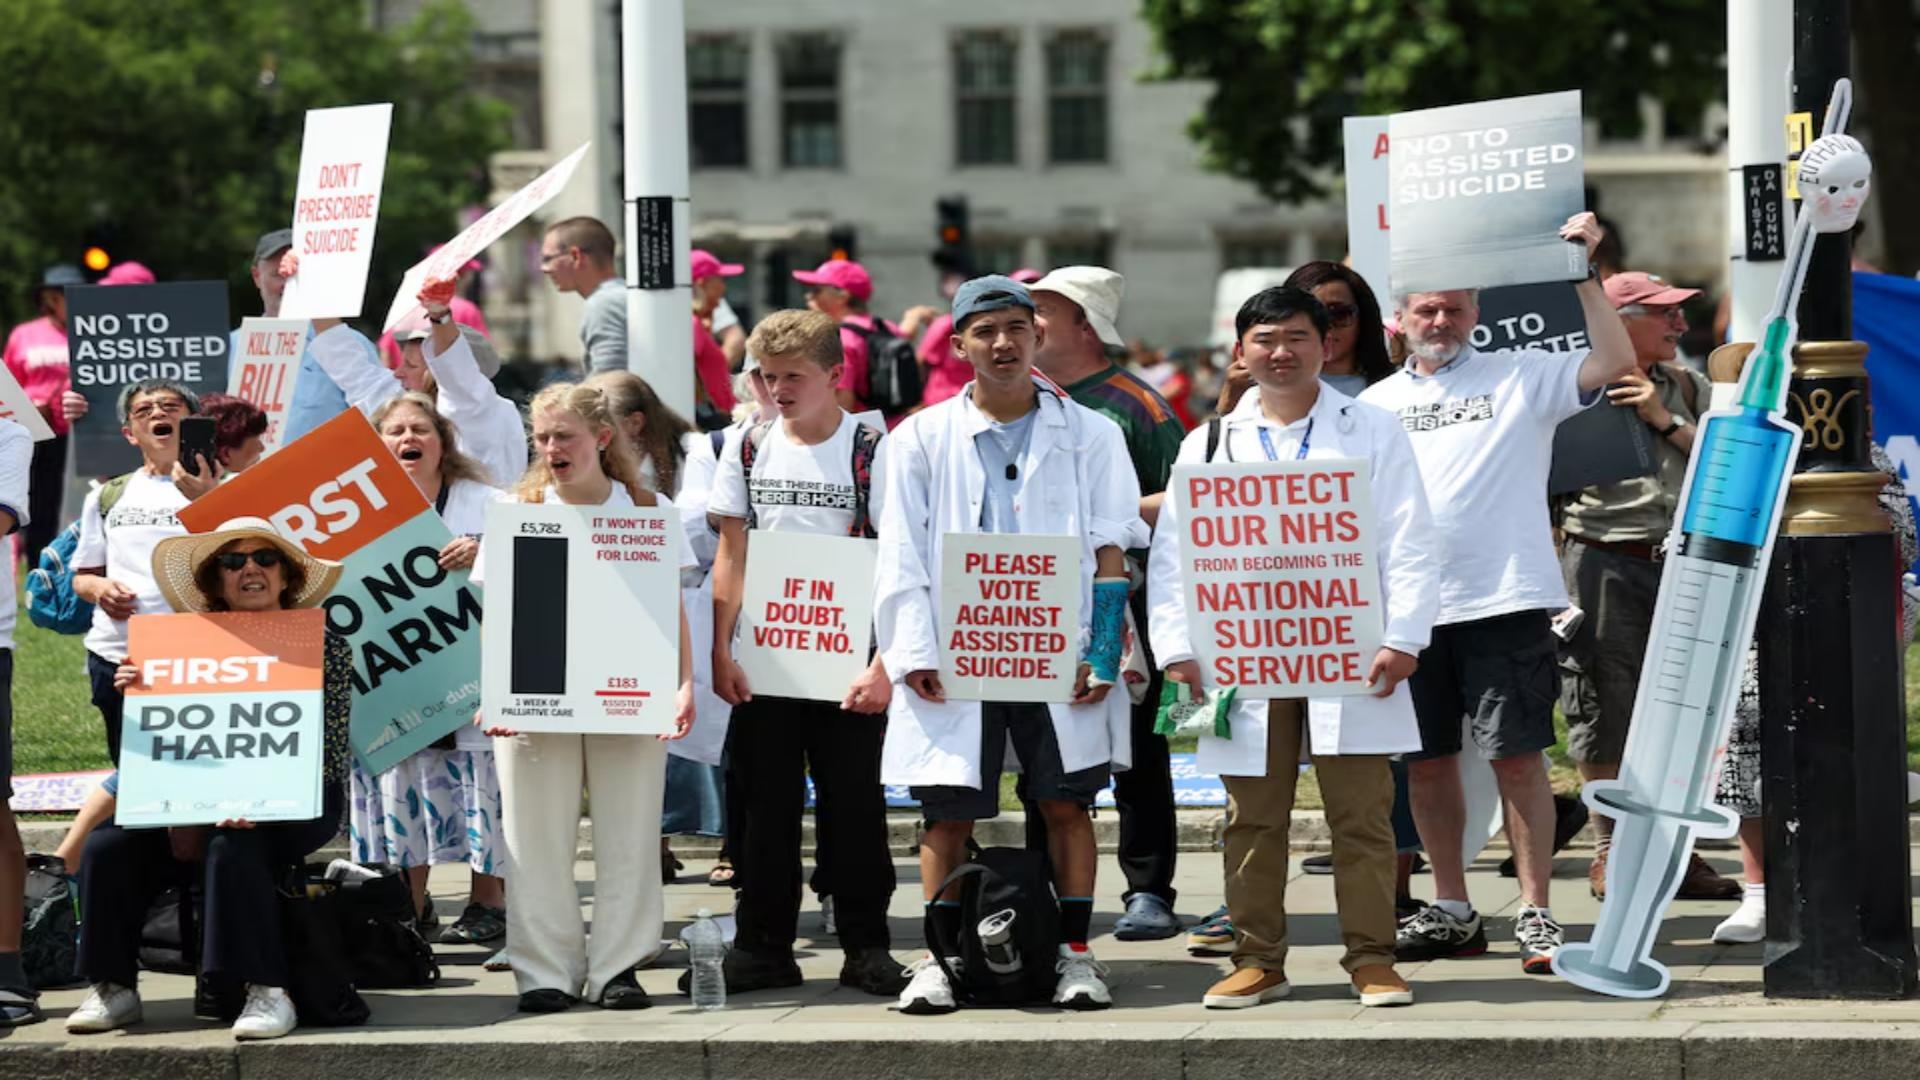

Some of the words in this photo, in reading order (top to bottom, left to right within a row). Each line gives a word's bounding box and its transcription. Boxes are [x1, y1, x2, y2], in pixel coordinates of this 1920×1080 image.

[1400, 134, 1450, 158] NO
[1460, 127, 1509, 149] TO
[1400, 143, 1576, 181] ASSISTED
[319, 162, 363, 189] DON'T
[1400, 169, 1546, 204] SUICIDE
[1764, 170, 1776, 191] DA
[298, 193, 375, 223] PRESCRIBE
[1750, 175, 1763, 250] TRISTAN
[303, 227, 359, 255] SUICIDE
[1765, 202, 1779, 255] CUNHA
[74, 314, 120, 336] NO
[126, 312, 169, 334] TO
[1470, 324, 1494, 348] O
[1497, 312, 1546, 341] TO
[75, 335, 226, 361] ASSISTED
[246, 331, 273, 356] KILL
[275, 331, 299, 356] THE
[77, 360, 202, 386] SUICIDE
[238, 362, 287, 412] BILL
[785, 479, 822, 490] THERE
[1189, 471, 1355, 508] PROTECT
[268, 456, 389, 552] RST
[797, 492, 811, 506] IS
[812, 494, 857, 508] HOPE
[1750, 507, 1760, 518] 2
[520, 522, 562, 535] £5,782
[592, 517, 604, 528] IT
[606, 518, 647, 530] WON'T
[649, 519, 666, 530] BE
[1190, 514, 1268, 547] OUR
[1279, 510, 1361, 544] NHS
[591, 534, 618, 545] OUR
[621, 535, 666, 546] CHOICE
[596, 550, 621, 561] FOR
[624, 550, 661, 562] LONG.
[965, 553, 1057, 576] PLEASE
[1193, 557, 1238, 573] FROM
[1243, 555, 1327, 571] BECOMING
[1332, 552, 1364, 568] THE
[324, 594, 363, 637] O
[361, 545, 450, 614] NO
[783, 577, 805, 598] IF
[810, 579, 834, 601] IN
[978, 579, 1041, 601] VOTE
[1734, 572, 1745, 584] 3
[1195, 577, 1370, 612] NATIONAL
[765, 601, 848, 631] DOUBT,
[955, 604, 1062, 628] AGAINST
[753, 625, 810, 651] VOTE
[815, 631, 854, 654] NO.
[949, 630, 1067, 654] ASSISTED
[1214, 615, 1356, 649] SUICIDE
[142, 655, 279, 686] FIRST
[955, 655, 1058, 680] SUICIDE.
[1214, 652, 1363, 687] SERVICE
[607, 677, 639, 689] £183
[140, 703, 215, 732] DO
[229, 701, 303, 729] NO
[501, 708, 549, 717] PALLIATIVE
[551, 708, 574, 718] CARE
[523, 699, 548, 707] WEEK
[549, 699, 561, 708] OF
[602, 699, 643, 708] ASSISTED
[605, 708, 640, 717] SUICIDE
[151, 731, 299, 762] HARM
